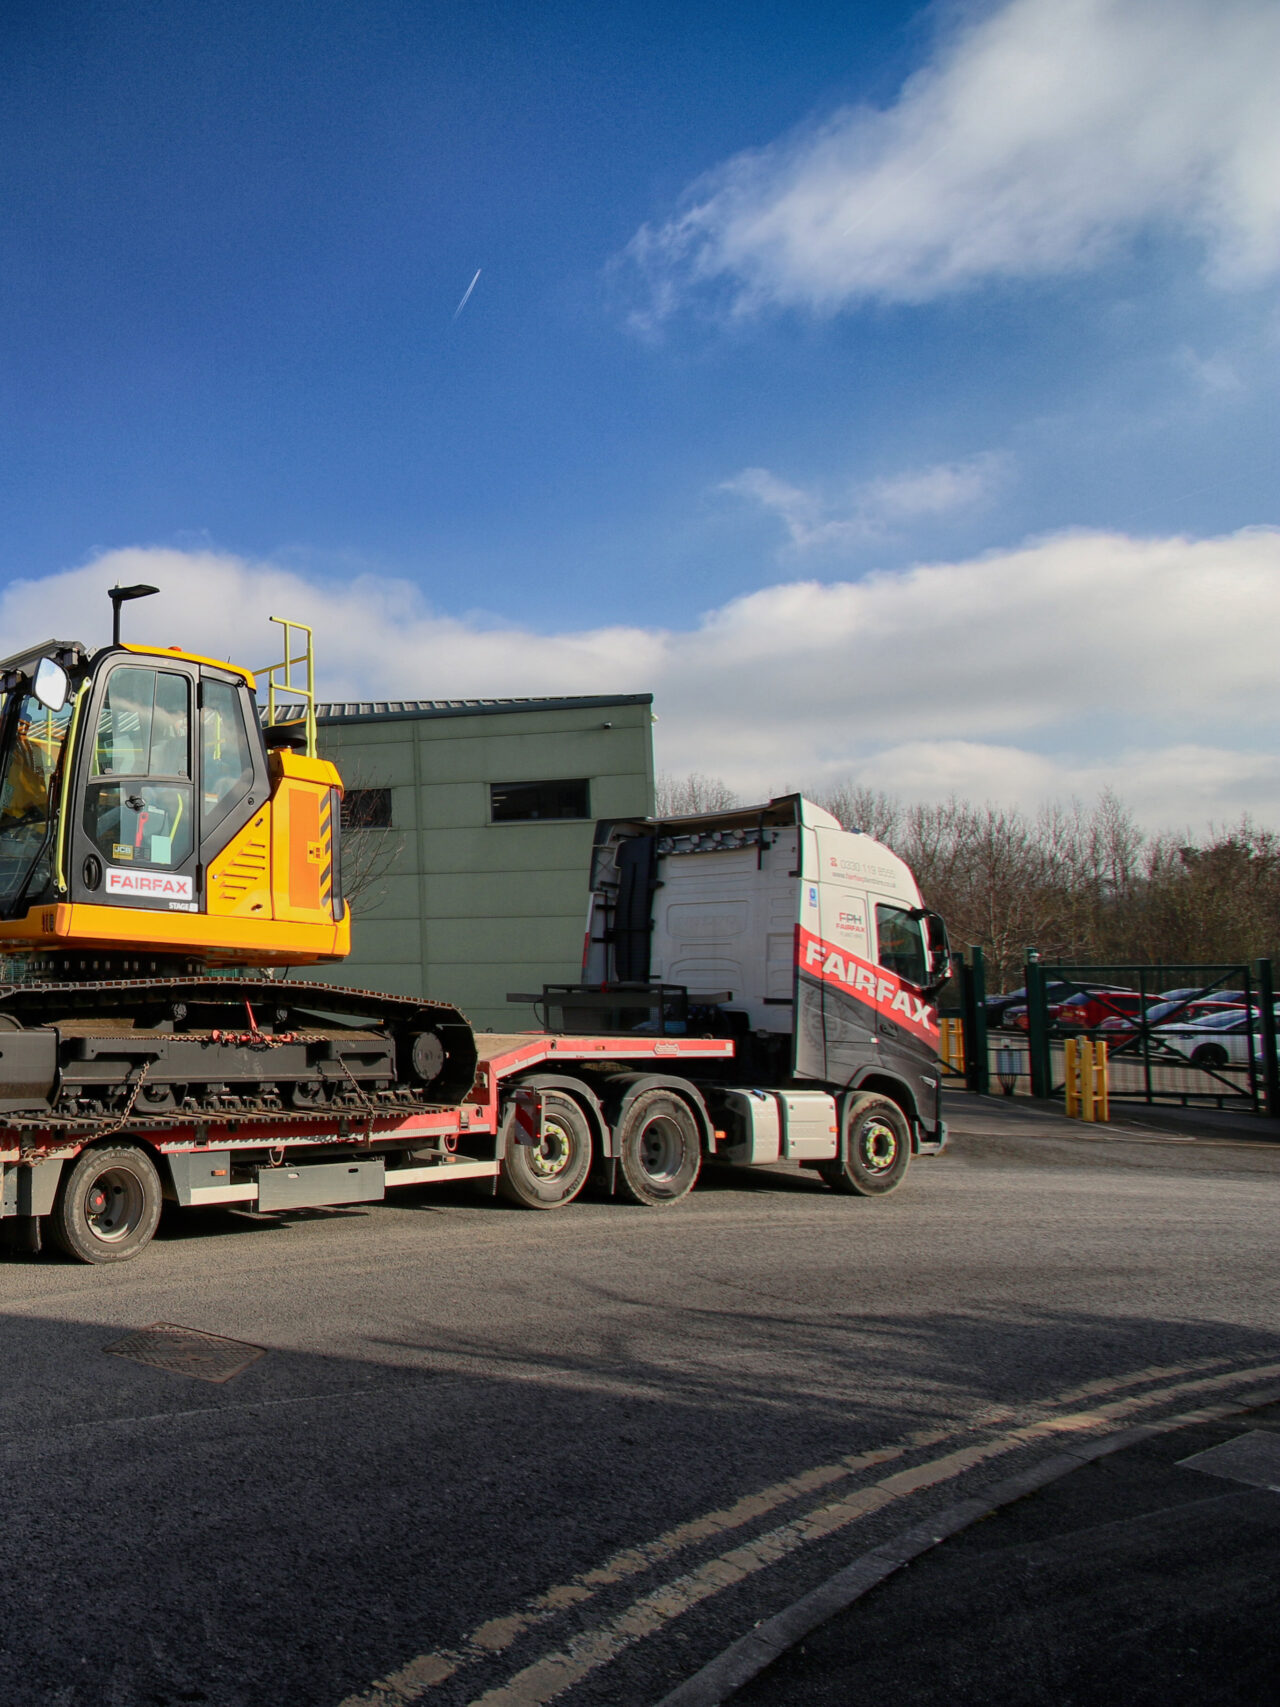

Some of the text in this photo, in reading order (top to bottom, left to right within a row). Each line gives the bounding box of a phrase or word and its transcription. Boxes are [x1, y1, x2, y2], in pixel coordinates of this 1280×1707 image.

[114, 846, 131, 854] JCB
[110, 874, 188, 894] FAIRFAX
[169, 902, 189, 911] STAGE
[839, 912, 862, 925] FPH
[805, 940, 934, 1030] FAIRFAX
